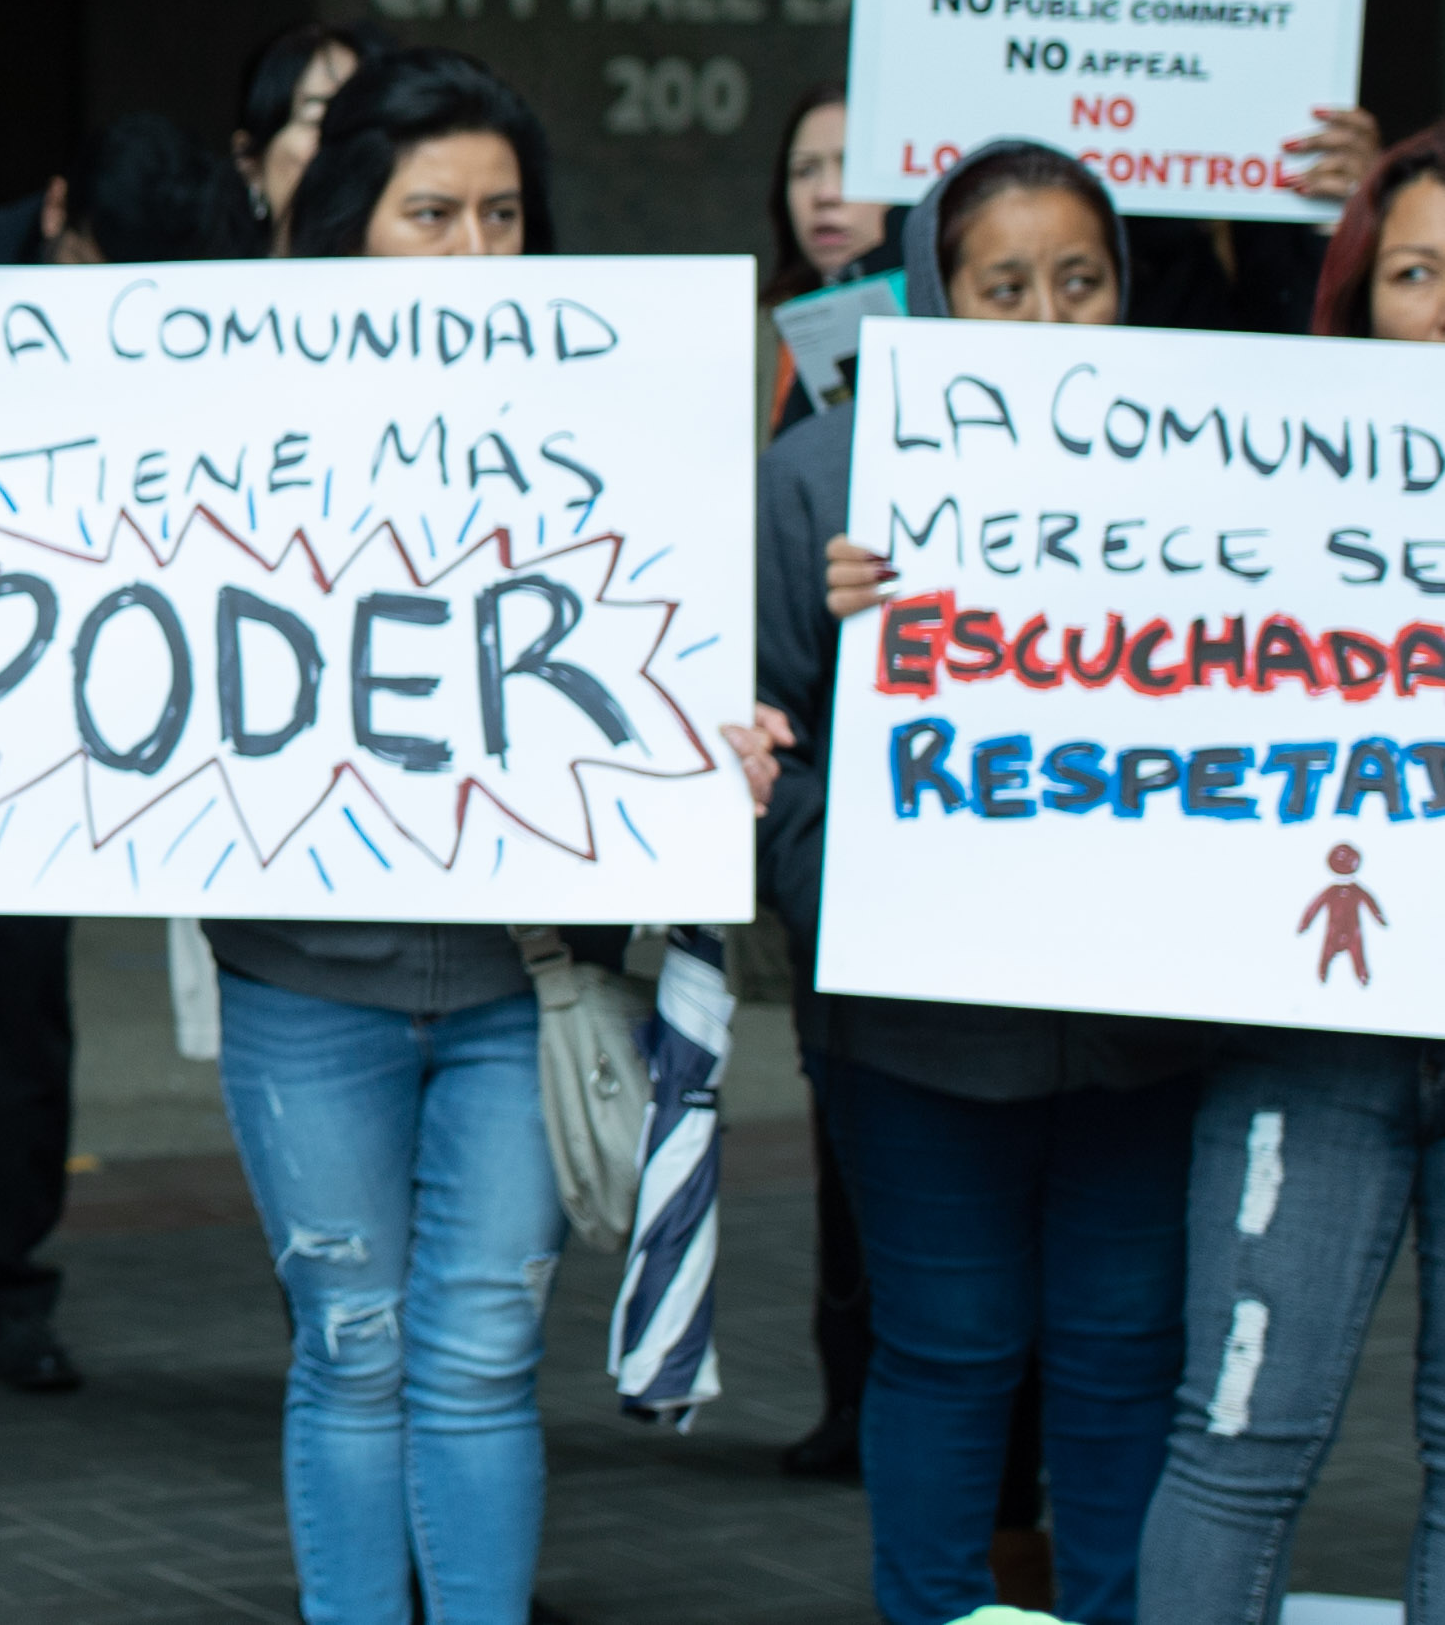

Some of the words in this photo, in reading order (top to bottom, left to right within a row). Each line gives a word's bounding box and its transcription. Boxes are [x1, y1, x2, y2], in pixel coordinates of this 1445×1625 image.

[605, 54, 752, 136] 200
[1005, 38, 1070, 74] NO
[1078, 51, 1210, 81] APPEAL
[1071, 96, 1136, 128] NO
[110, 278, 619, 367] COMUNIDAD
[889, 344, 1018, 458] LA
[369, 401, 607, 510] MÁS
[887, 495, 1273, 588] MERECE
